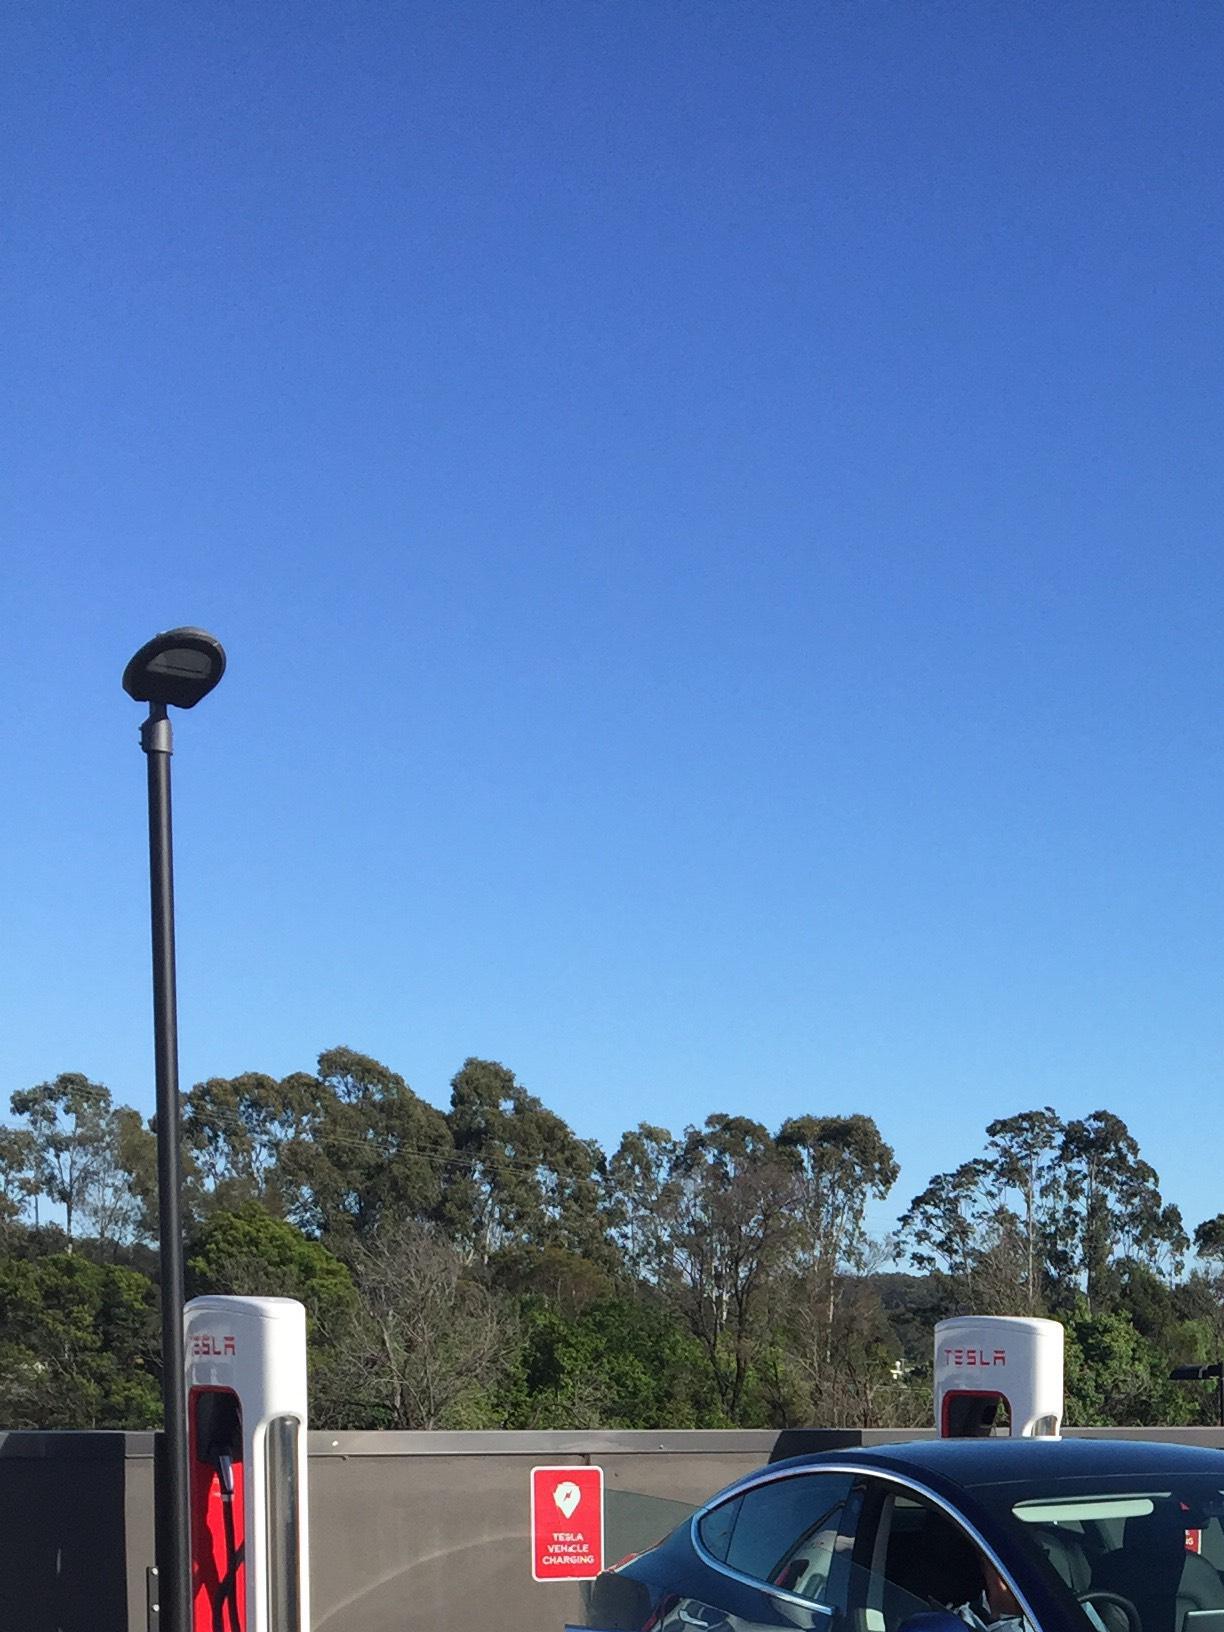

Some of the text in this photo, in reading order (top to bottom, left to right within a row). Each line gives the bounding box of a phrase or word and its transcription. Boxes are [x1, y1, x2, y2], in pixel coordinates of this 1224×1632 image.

[943, 1348, 1006, 1367] TESLA
[552, 1532, 584, 1542] TESLA
[547, 1543, 590, 1553] VEHICLE
[542, 1554, 595, 1565] CHARGING
